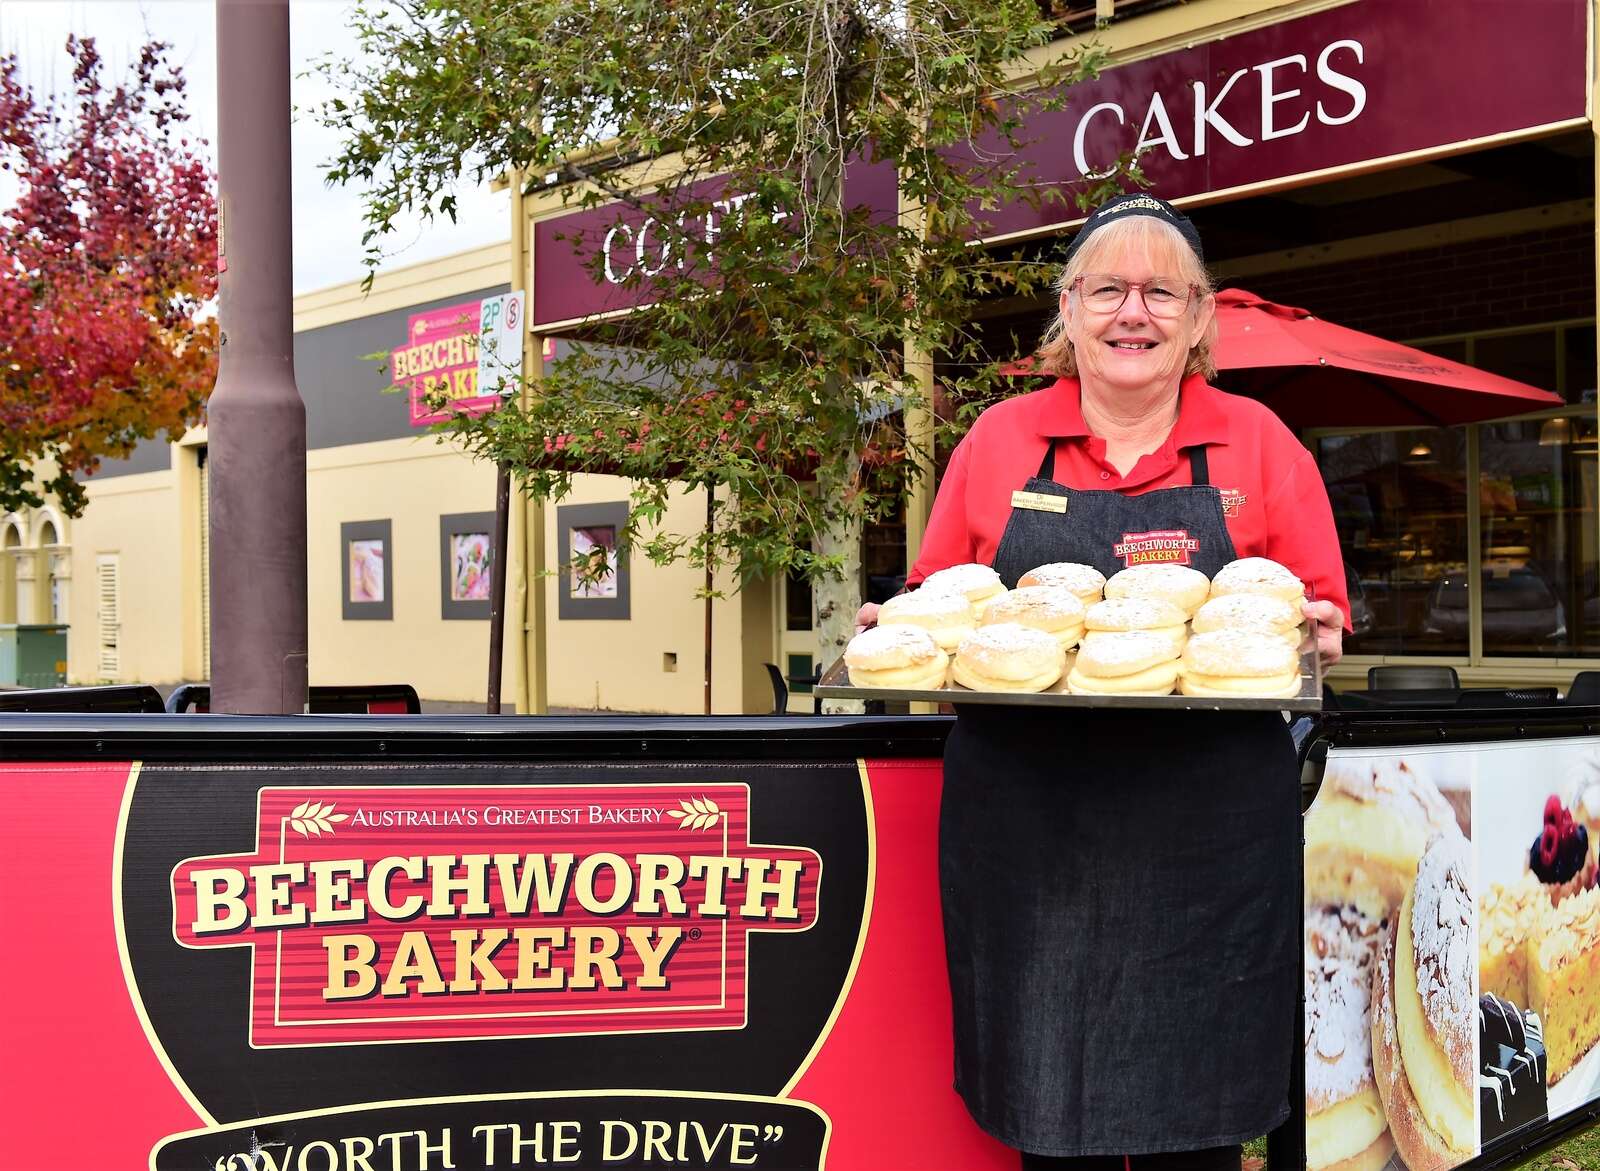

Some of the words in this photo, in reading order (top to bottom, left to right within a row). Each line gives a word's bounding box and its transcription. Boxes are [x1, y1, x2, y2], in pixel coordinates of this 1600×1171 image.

[1073, 39, 1367, 180] CAKES
[1116, 539, 1196, 555] BEECHWORTH
[1132, 550, 1181, 563] BAKERY
[350, 807, 478, 827] AUSTRALIA'S
[483, 806, 582, 826] GREATEST
[587, 805, 665, 824] BAKERY
[189, 852, 804, 936] BEECHWORTH
[472, 1121, 582, 1166] THE
